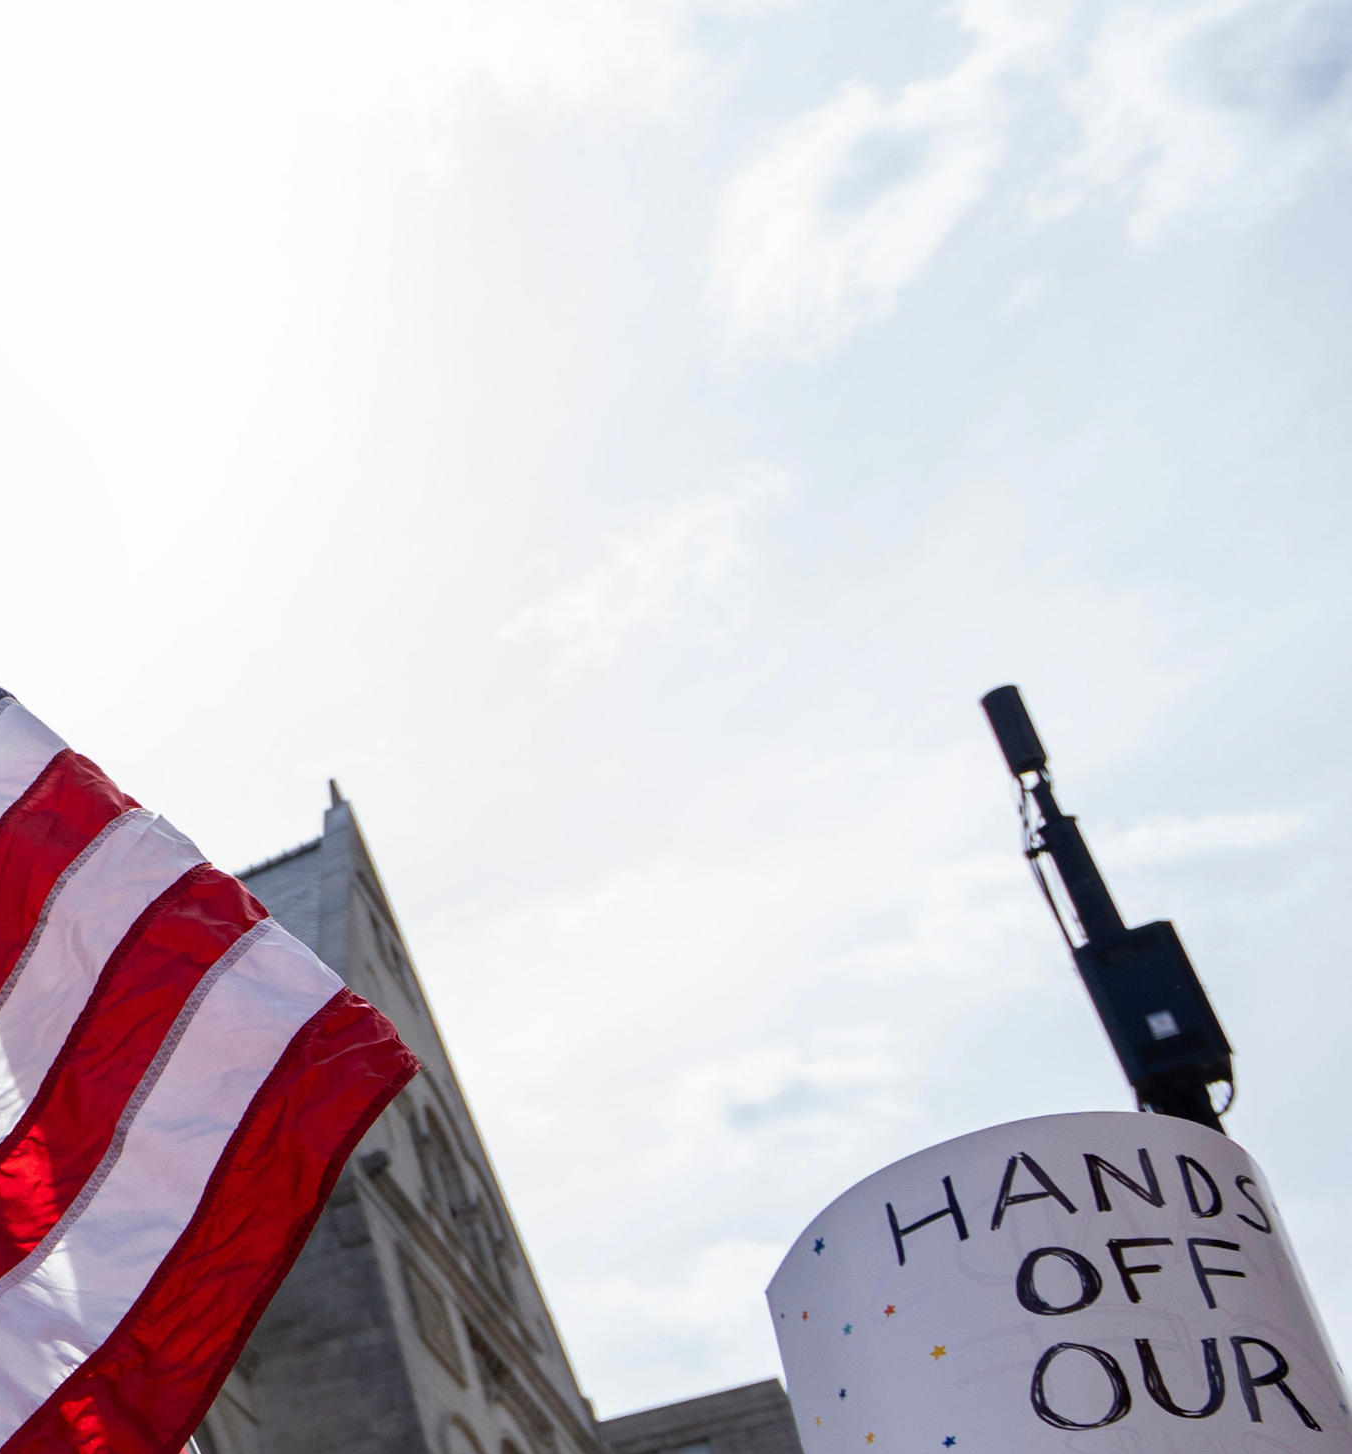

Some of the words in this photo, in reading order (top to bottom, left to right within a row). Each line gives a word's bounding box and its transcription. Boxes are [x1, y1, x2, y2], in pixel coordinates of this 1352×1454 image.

[886, 1148, 1273, 1266] HANDS
[1016, 1237, 1246, 1316] OFF
[1030, 1335, 1323, 1433] OUR
